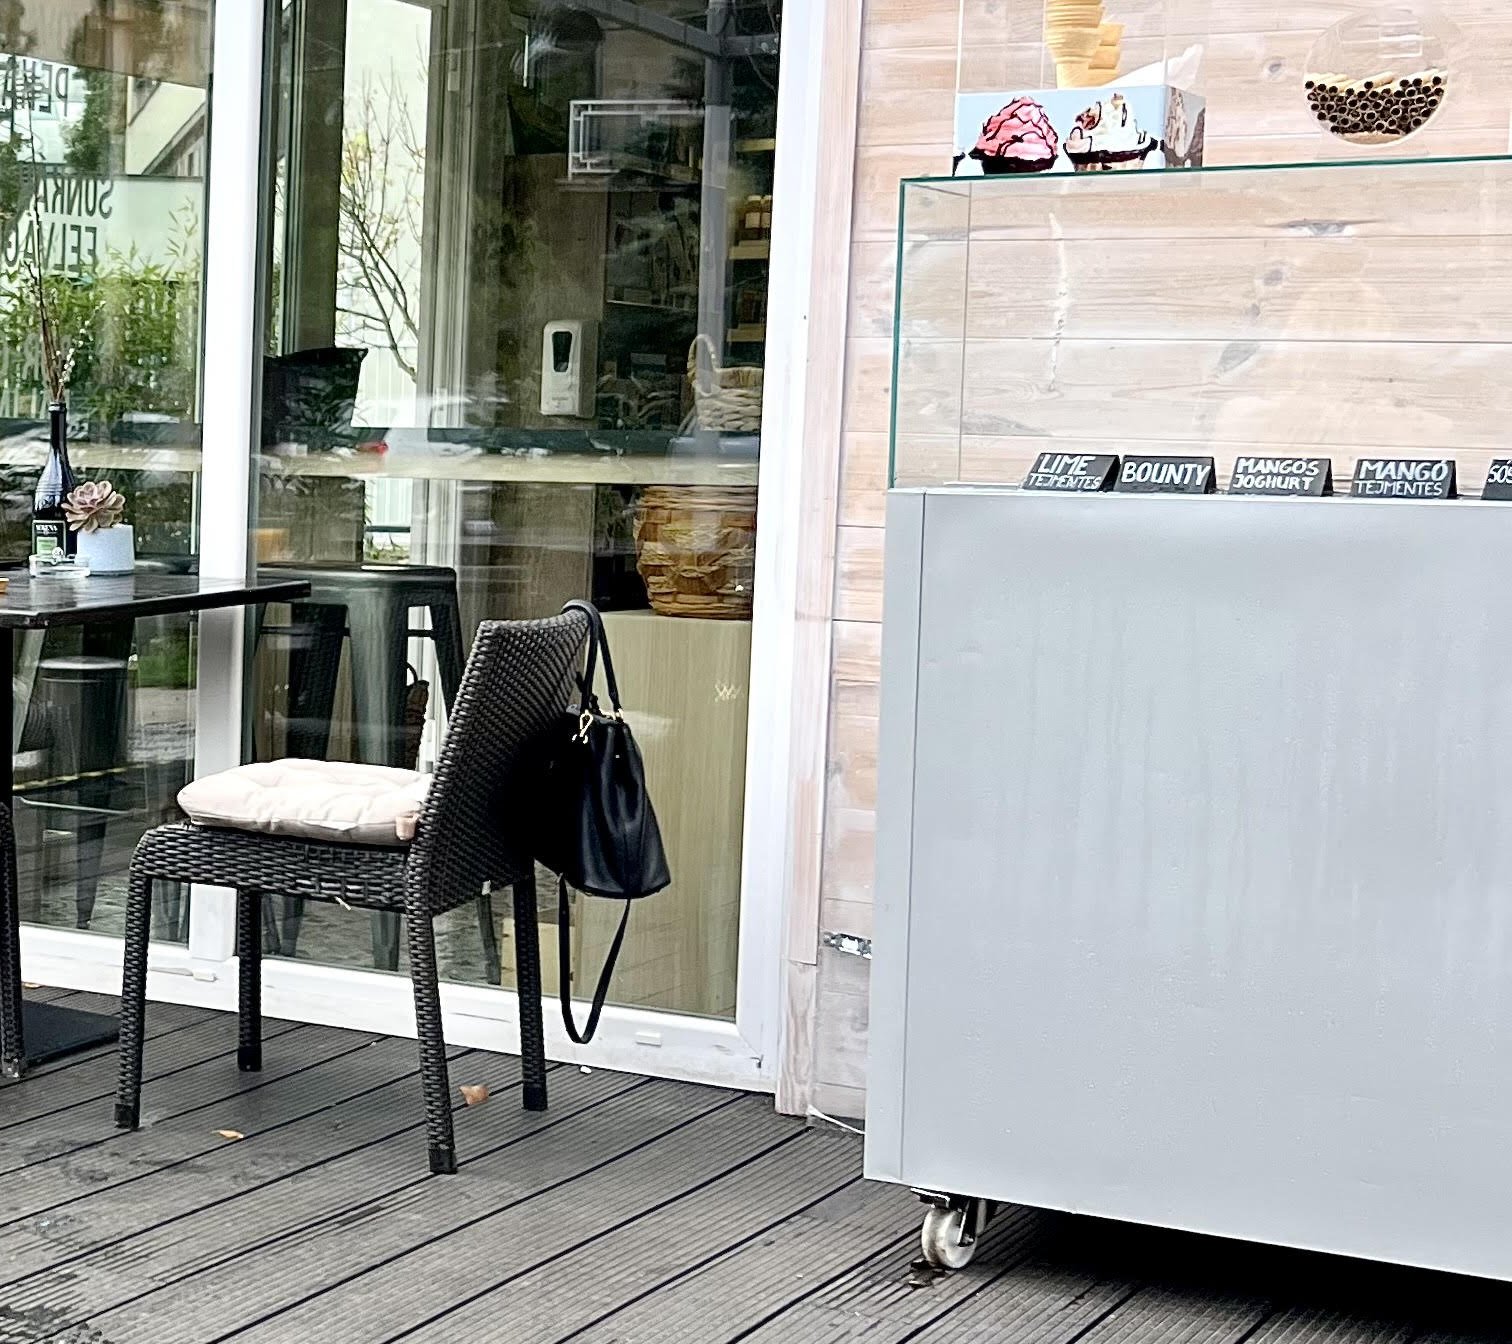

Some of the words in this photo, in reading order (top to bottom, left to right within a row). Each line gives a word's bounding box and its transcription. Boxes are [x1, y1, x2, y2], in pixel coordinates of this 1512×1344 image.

[1038, 454, 1096, 476] LIME
[1121, 461, 1211, 486] BOUNTY
[1359, 459, 1449, 482] MANGÓ
[1232, 474, 1314, 491] JOGHURT
[1354, 479, 1443, 497] TEJMENTES
